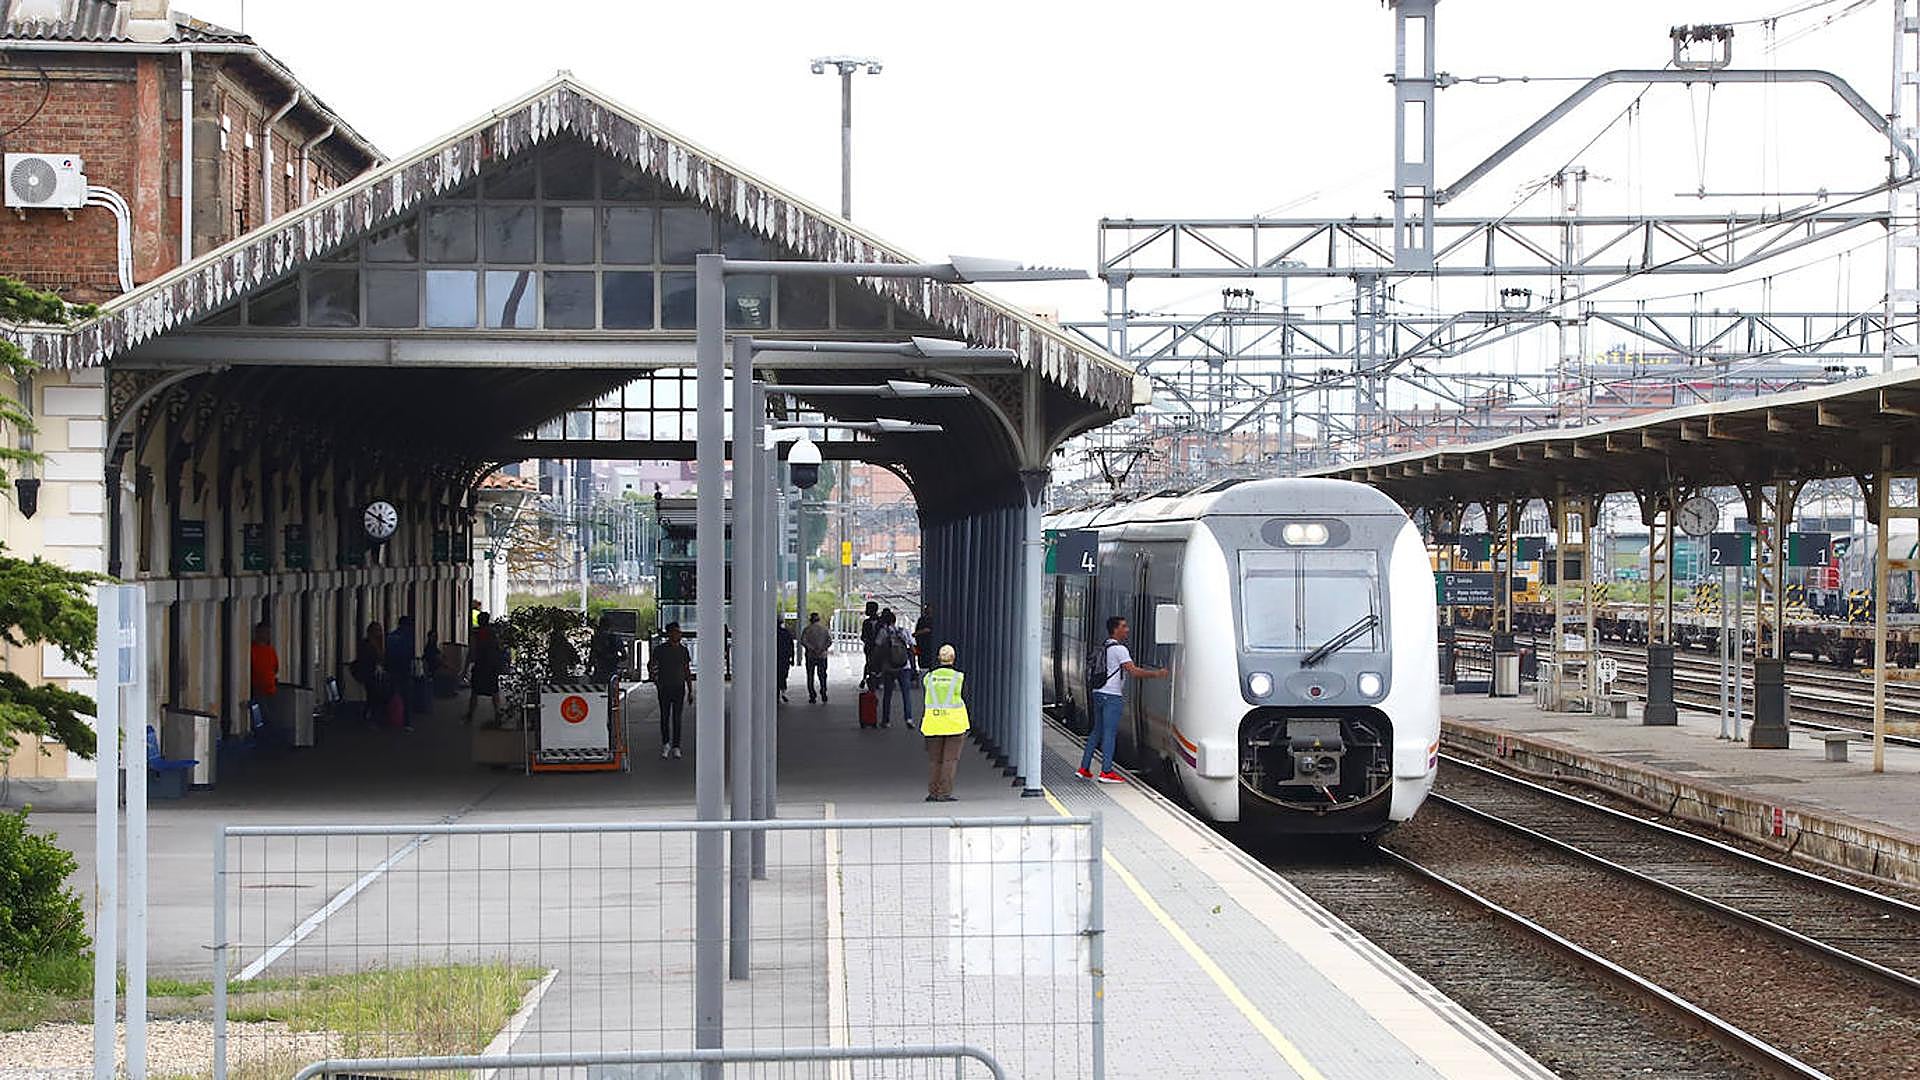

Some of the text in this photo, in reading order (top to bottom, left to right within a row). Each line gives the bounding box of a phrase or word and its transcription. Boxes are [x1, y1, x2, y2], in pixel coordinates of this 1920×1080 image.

[1081, 551, 1096, 573] 4
[1461, 548, 1469, 561] 2
[1537, 548, 1544, 561] 1
[1711, 548, 1721, 566] 2
[1818, 549, 1828, 566] 1
